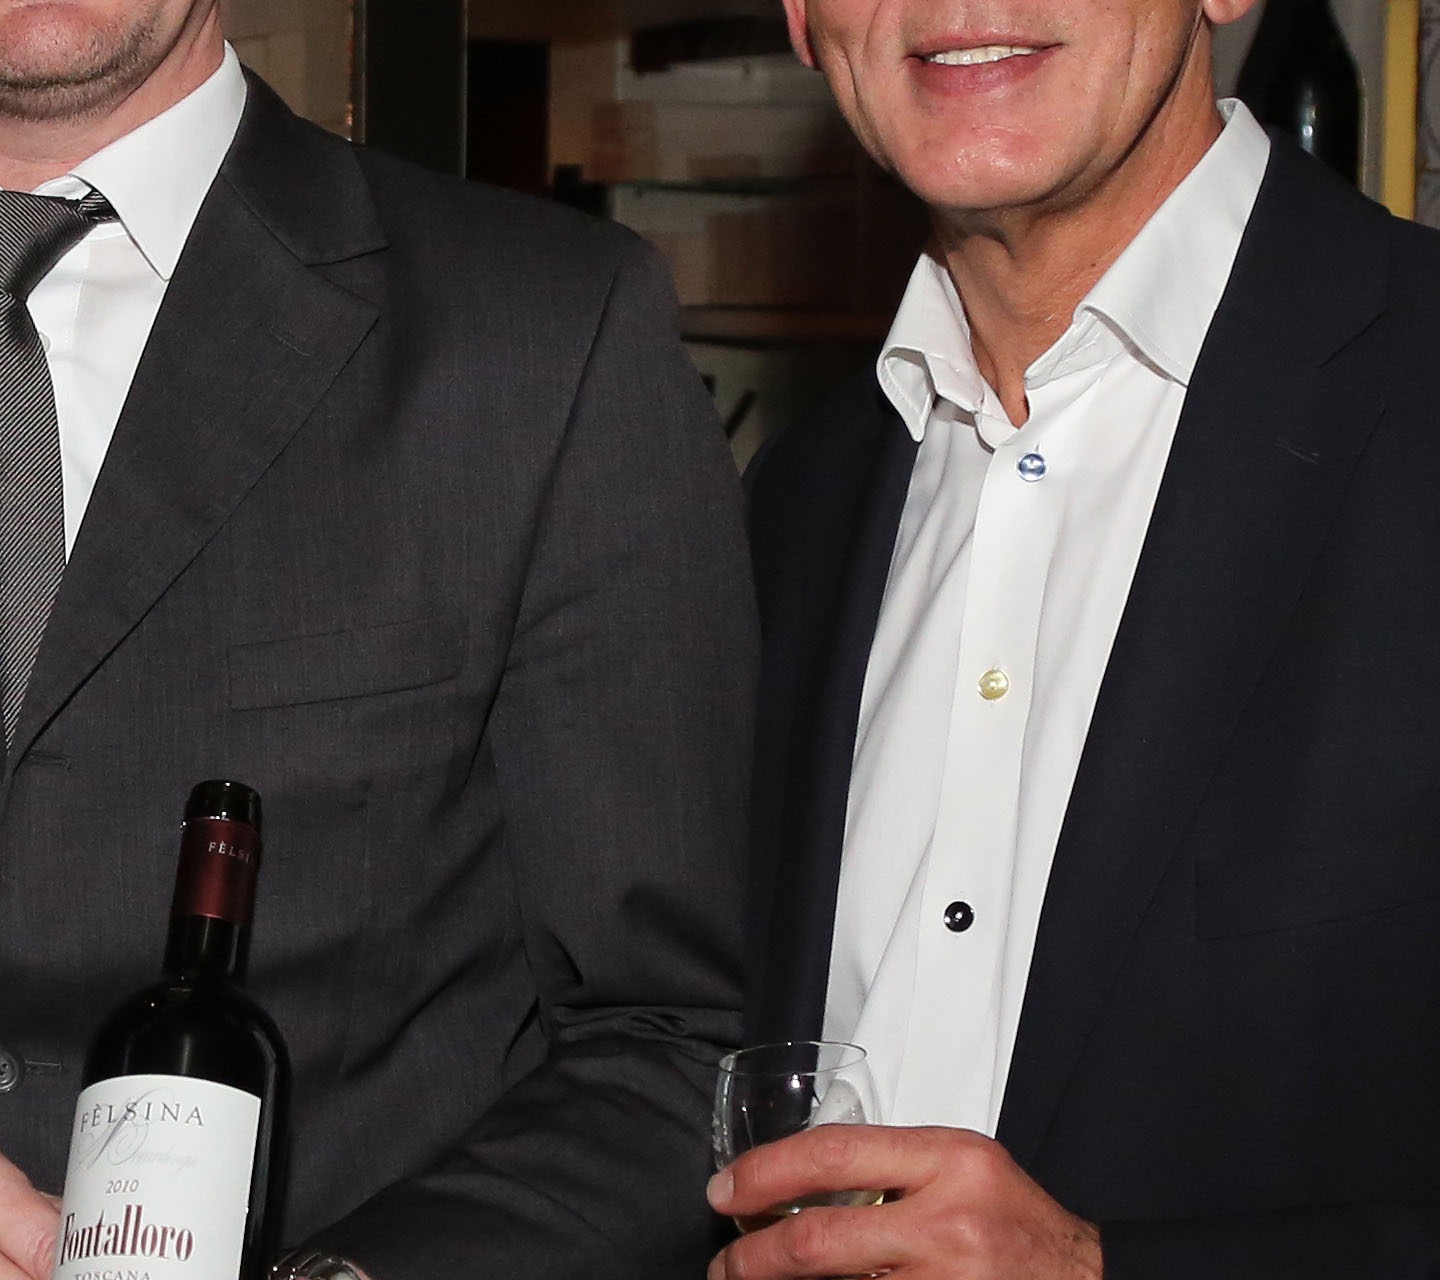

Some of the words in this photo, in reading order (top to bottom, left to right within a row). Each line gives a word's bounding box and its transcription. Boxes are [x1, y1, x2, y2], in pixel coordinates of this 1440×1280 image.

[79, 1100, 206, 1133] FÈLSINA
[105, 1178, 140, 1195] 2010
[60, 1204, 194, 1267] Fontalloro
